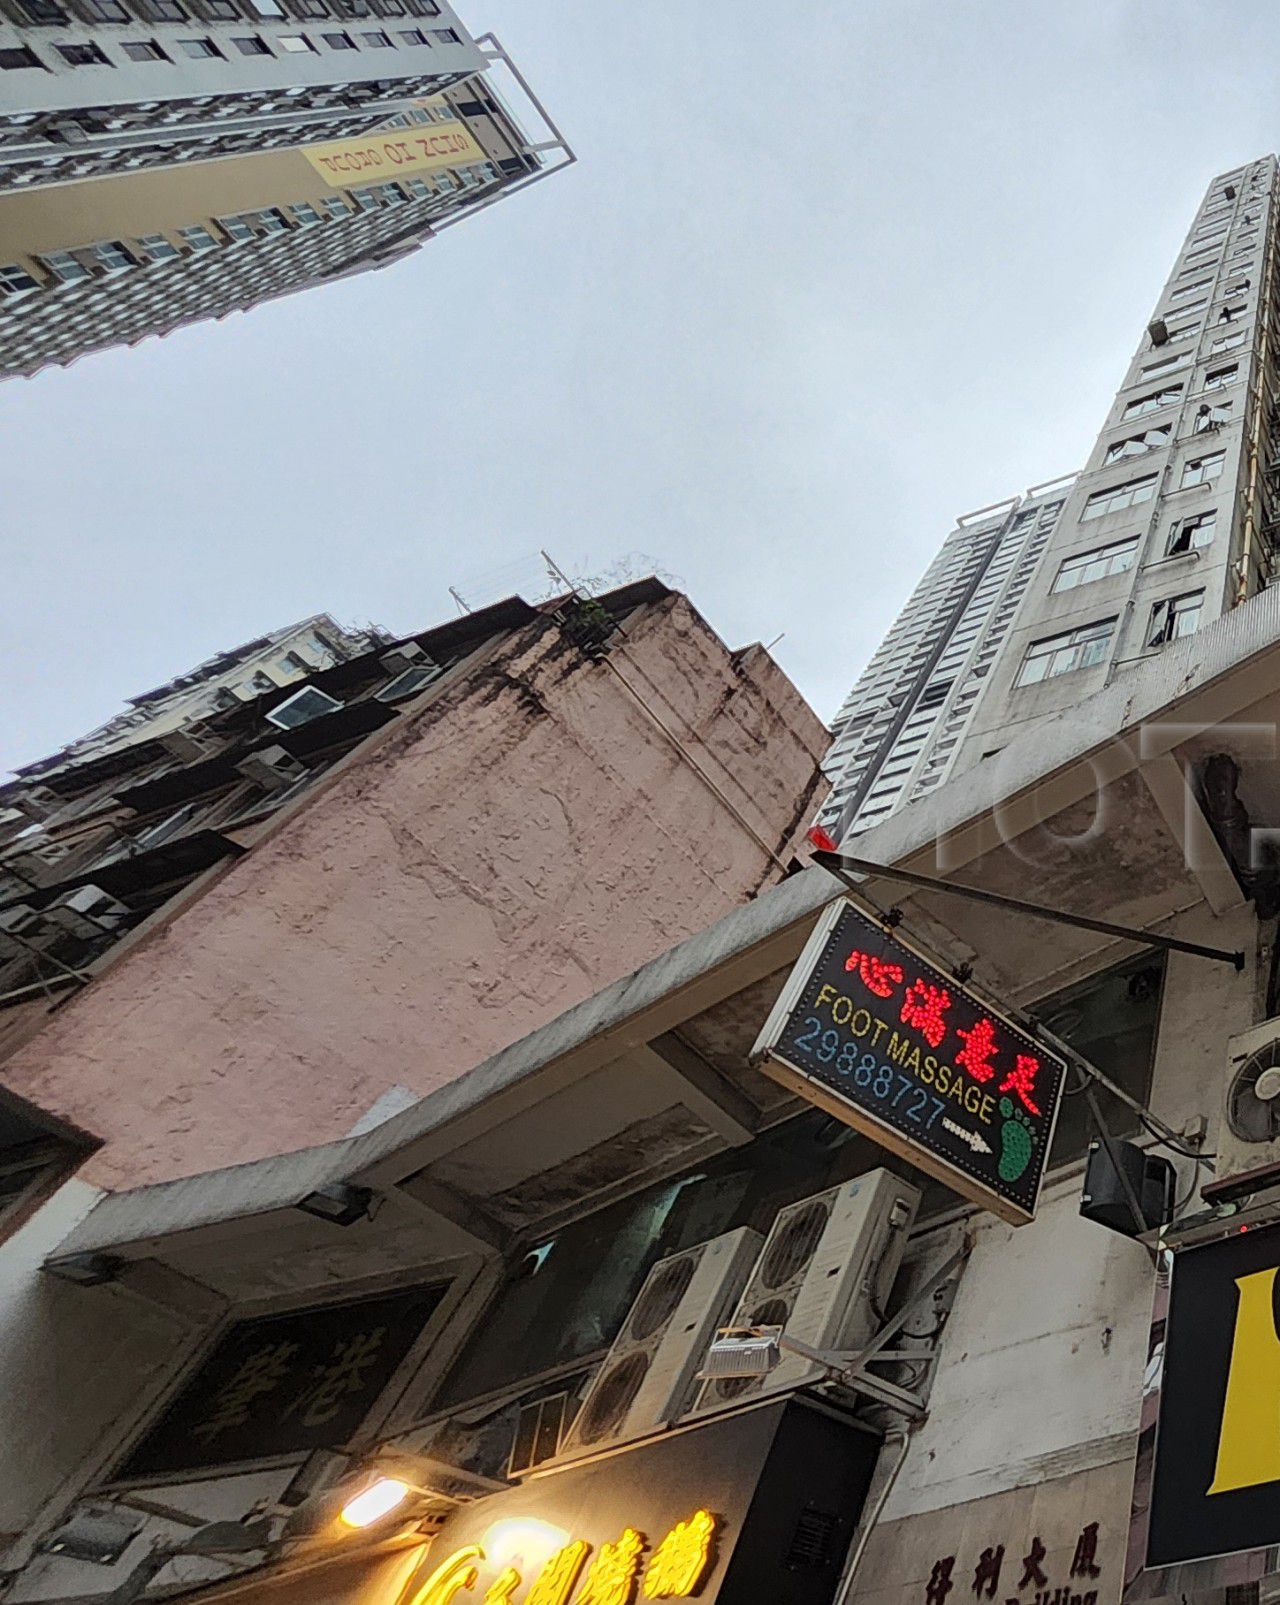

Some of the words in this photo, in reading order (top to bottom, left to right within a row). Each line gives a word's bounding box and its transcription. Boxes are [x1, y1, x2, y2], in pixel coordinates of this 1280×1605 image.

[384, 142, 416, 165] HO
[793, 1016, 946, 1130] 29888727
[813, 984, 889, 1047] FOOT
[885, 1030, 997, 1124] MASSAGE
